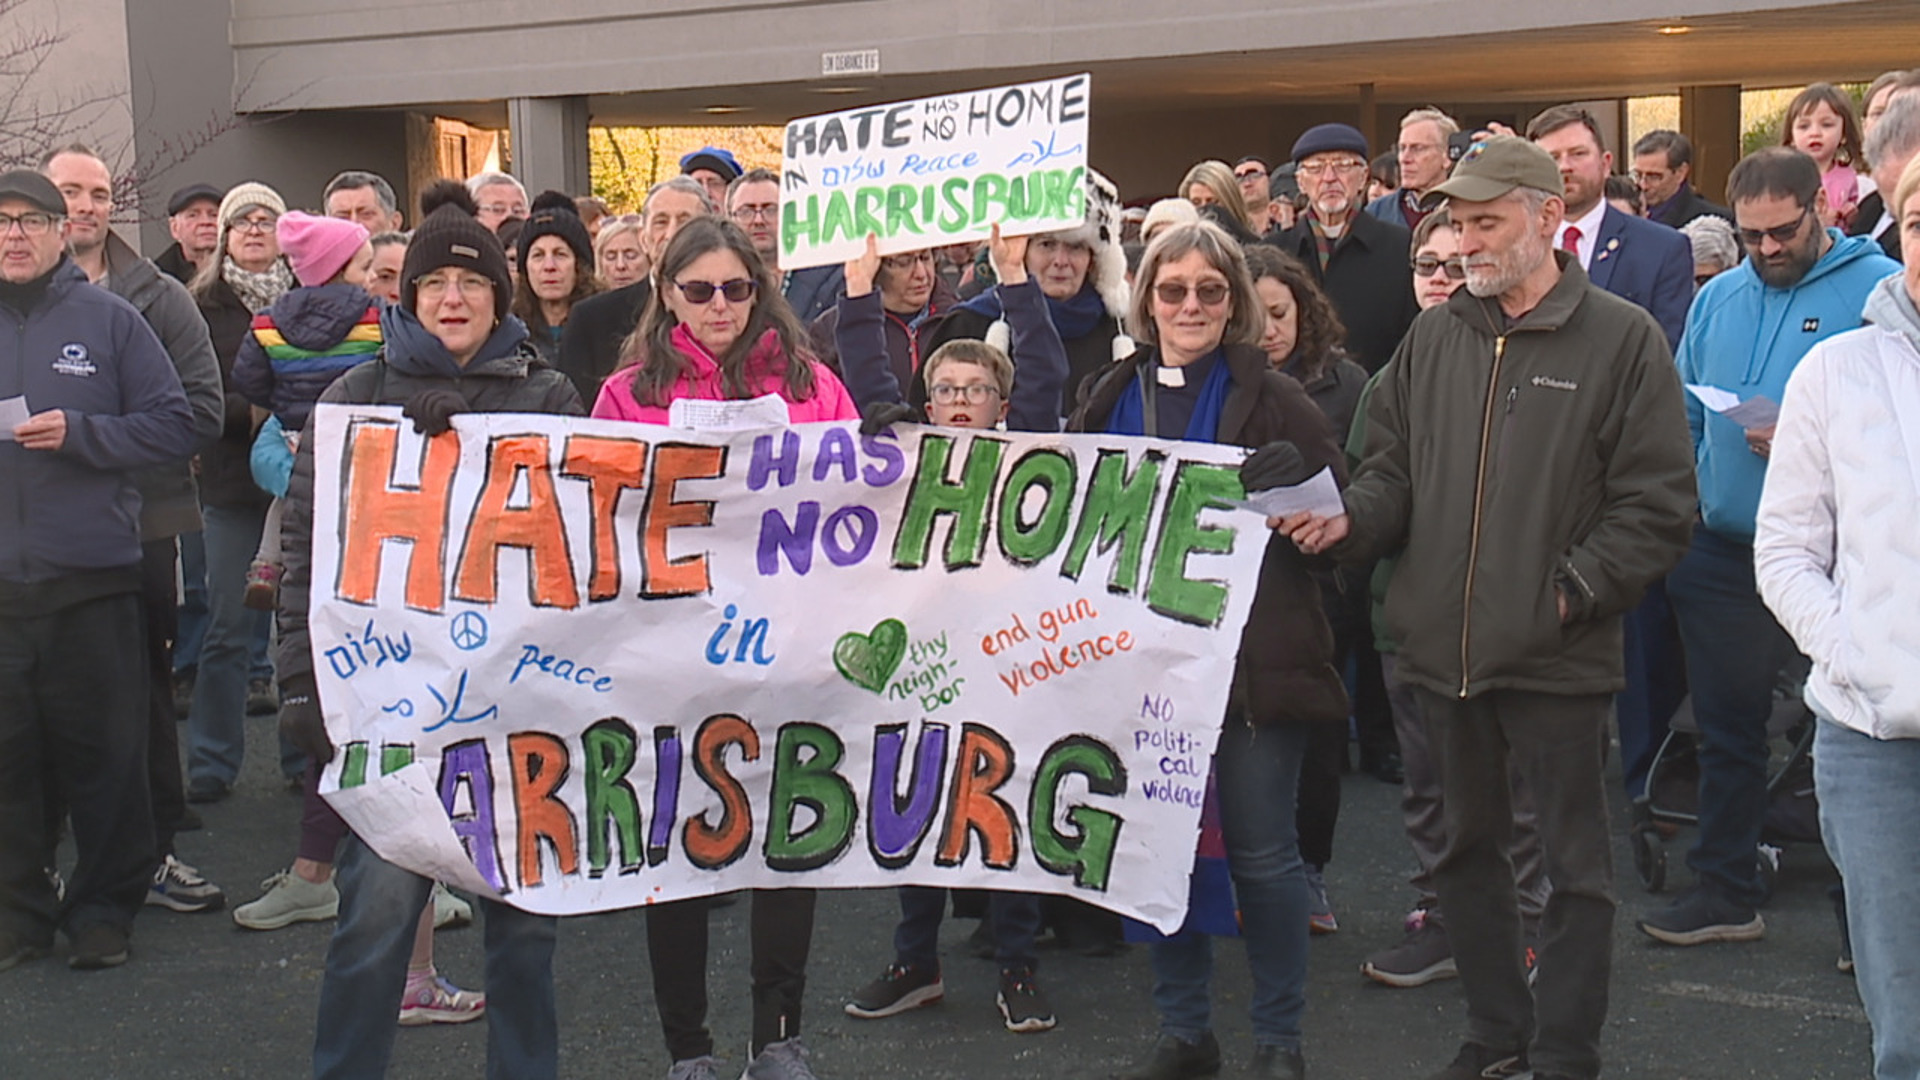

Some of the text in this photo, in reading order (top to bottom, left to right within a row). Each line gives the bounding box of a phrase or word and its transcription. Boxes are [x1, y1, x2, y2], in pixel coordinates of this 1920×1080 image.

[785, 77, 1087, 160] HATE HAS NO HOME
[786, 162, 808, 193] IN
[822, 156, 886, 187] שלום
[899, 151, 980, 176] Peace
[781, 165, 1085, 256] HARRISBURG
[335, 413, 1250, 629] HATE HAS NO HOME
[324, 618, 412, 680] שלום
[704, 602, 776, 666] in
[907, 629, 948, 667] thy
[981, 597, 1098, 657] end gun
[509, 643, 614, 693] peace
[888, 659, 958, 702] neigh-
[998, 630, 1136, 697] violence
[918, 677, 966, 714] bor
[1140, 693, 1175, 723] NO
[1158, 756, 1201, 778] cal
[339, 713, 1129, 892] ARRISBURG
[1142, 778, 1203, 809] violence
